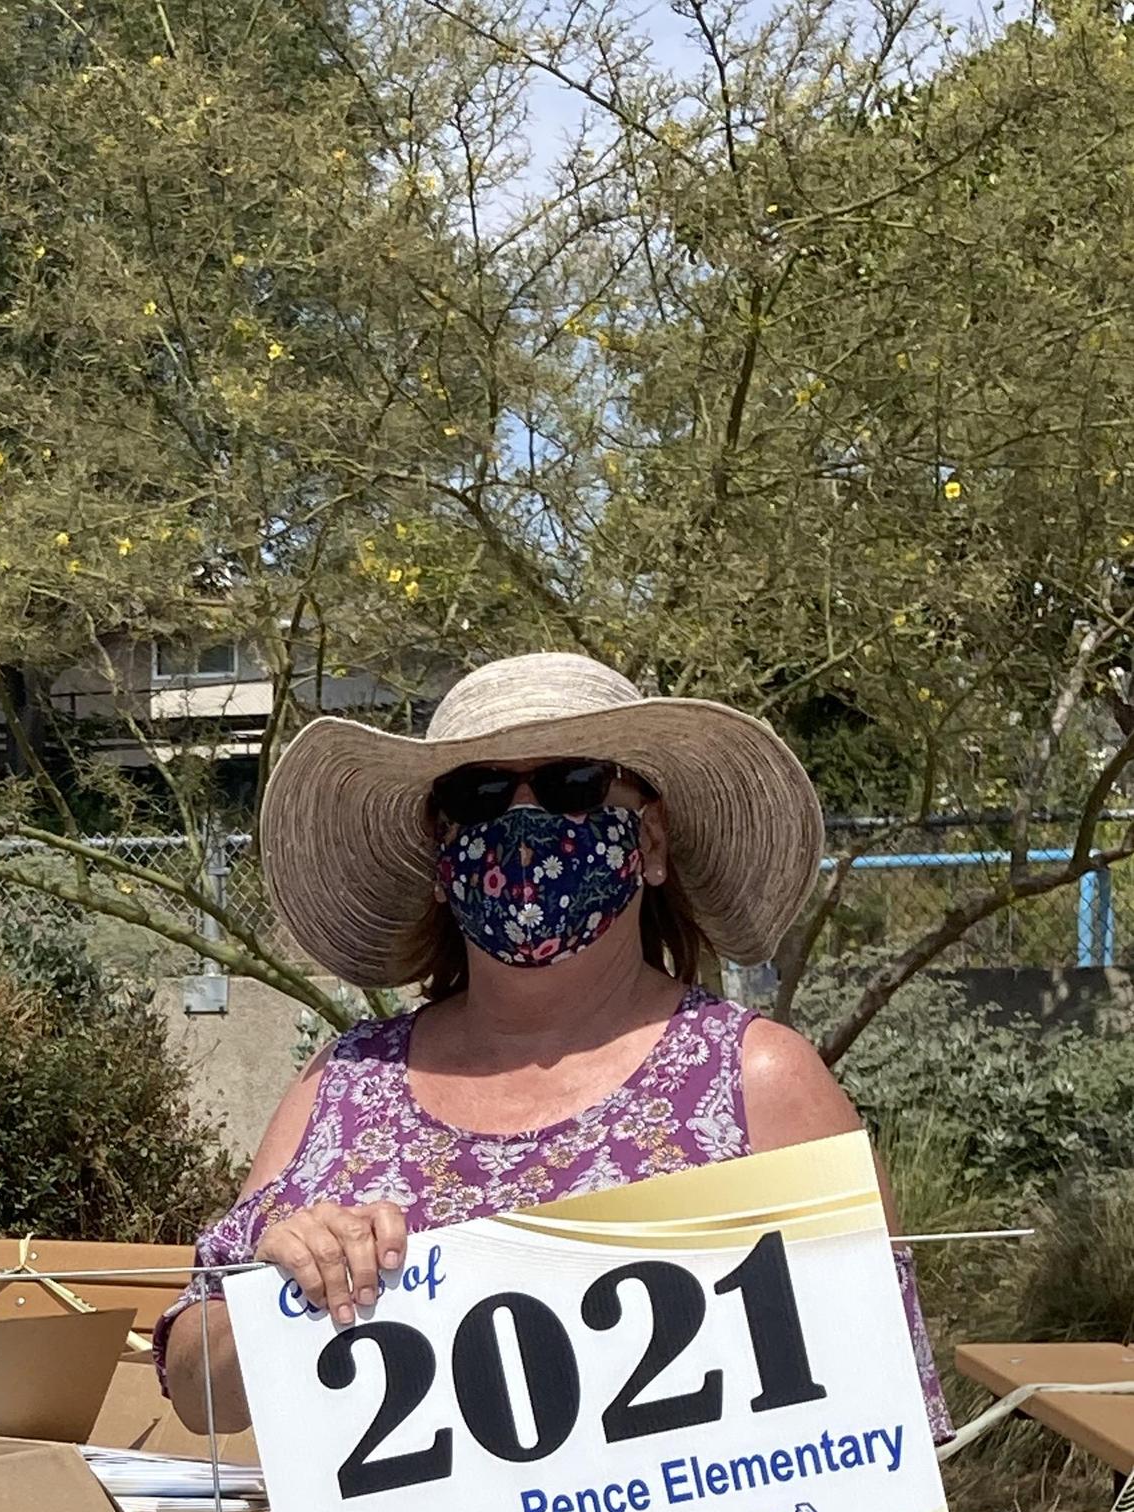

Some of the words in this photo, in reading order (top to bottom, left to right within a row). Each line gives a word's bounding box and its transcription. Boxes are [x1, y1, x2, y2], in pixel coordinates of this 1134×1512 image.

[402, 1245, 446, 1300] of
[317, 1230, 827, 1500] 2021
[661, 1425, 903, 1505] Elementary
